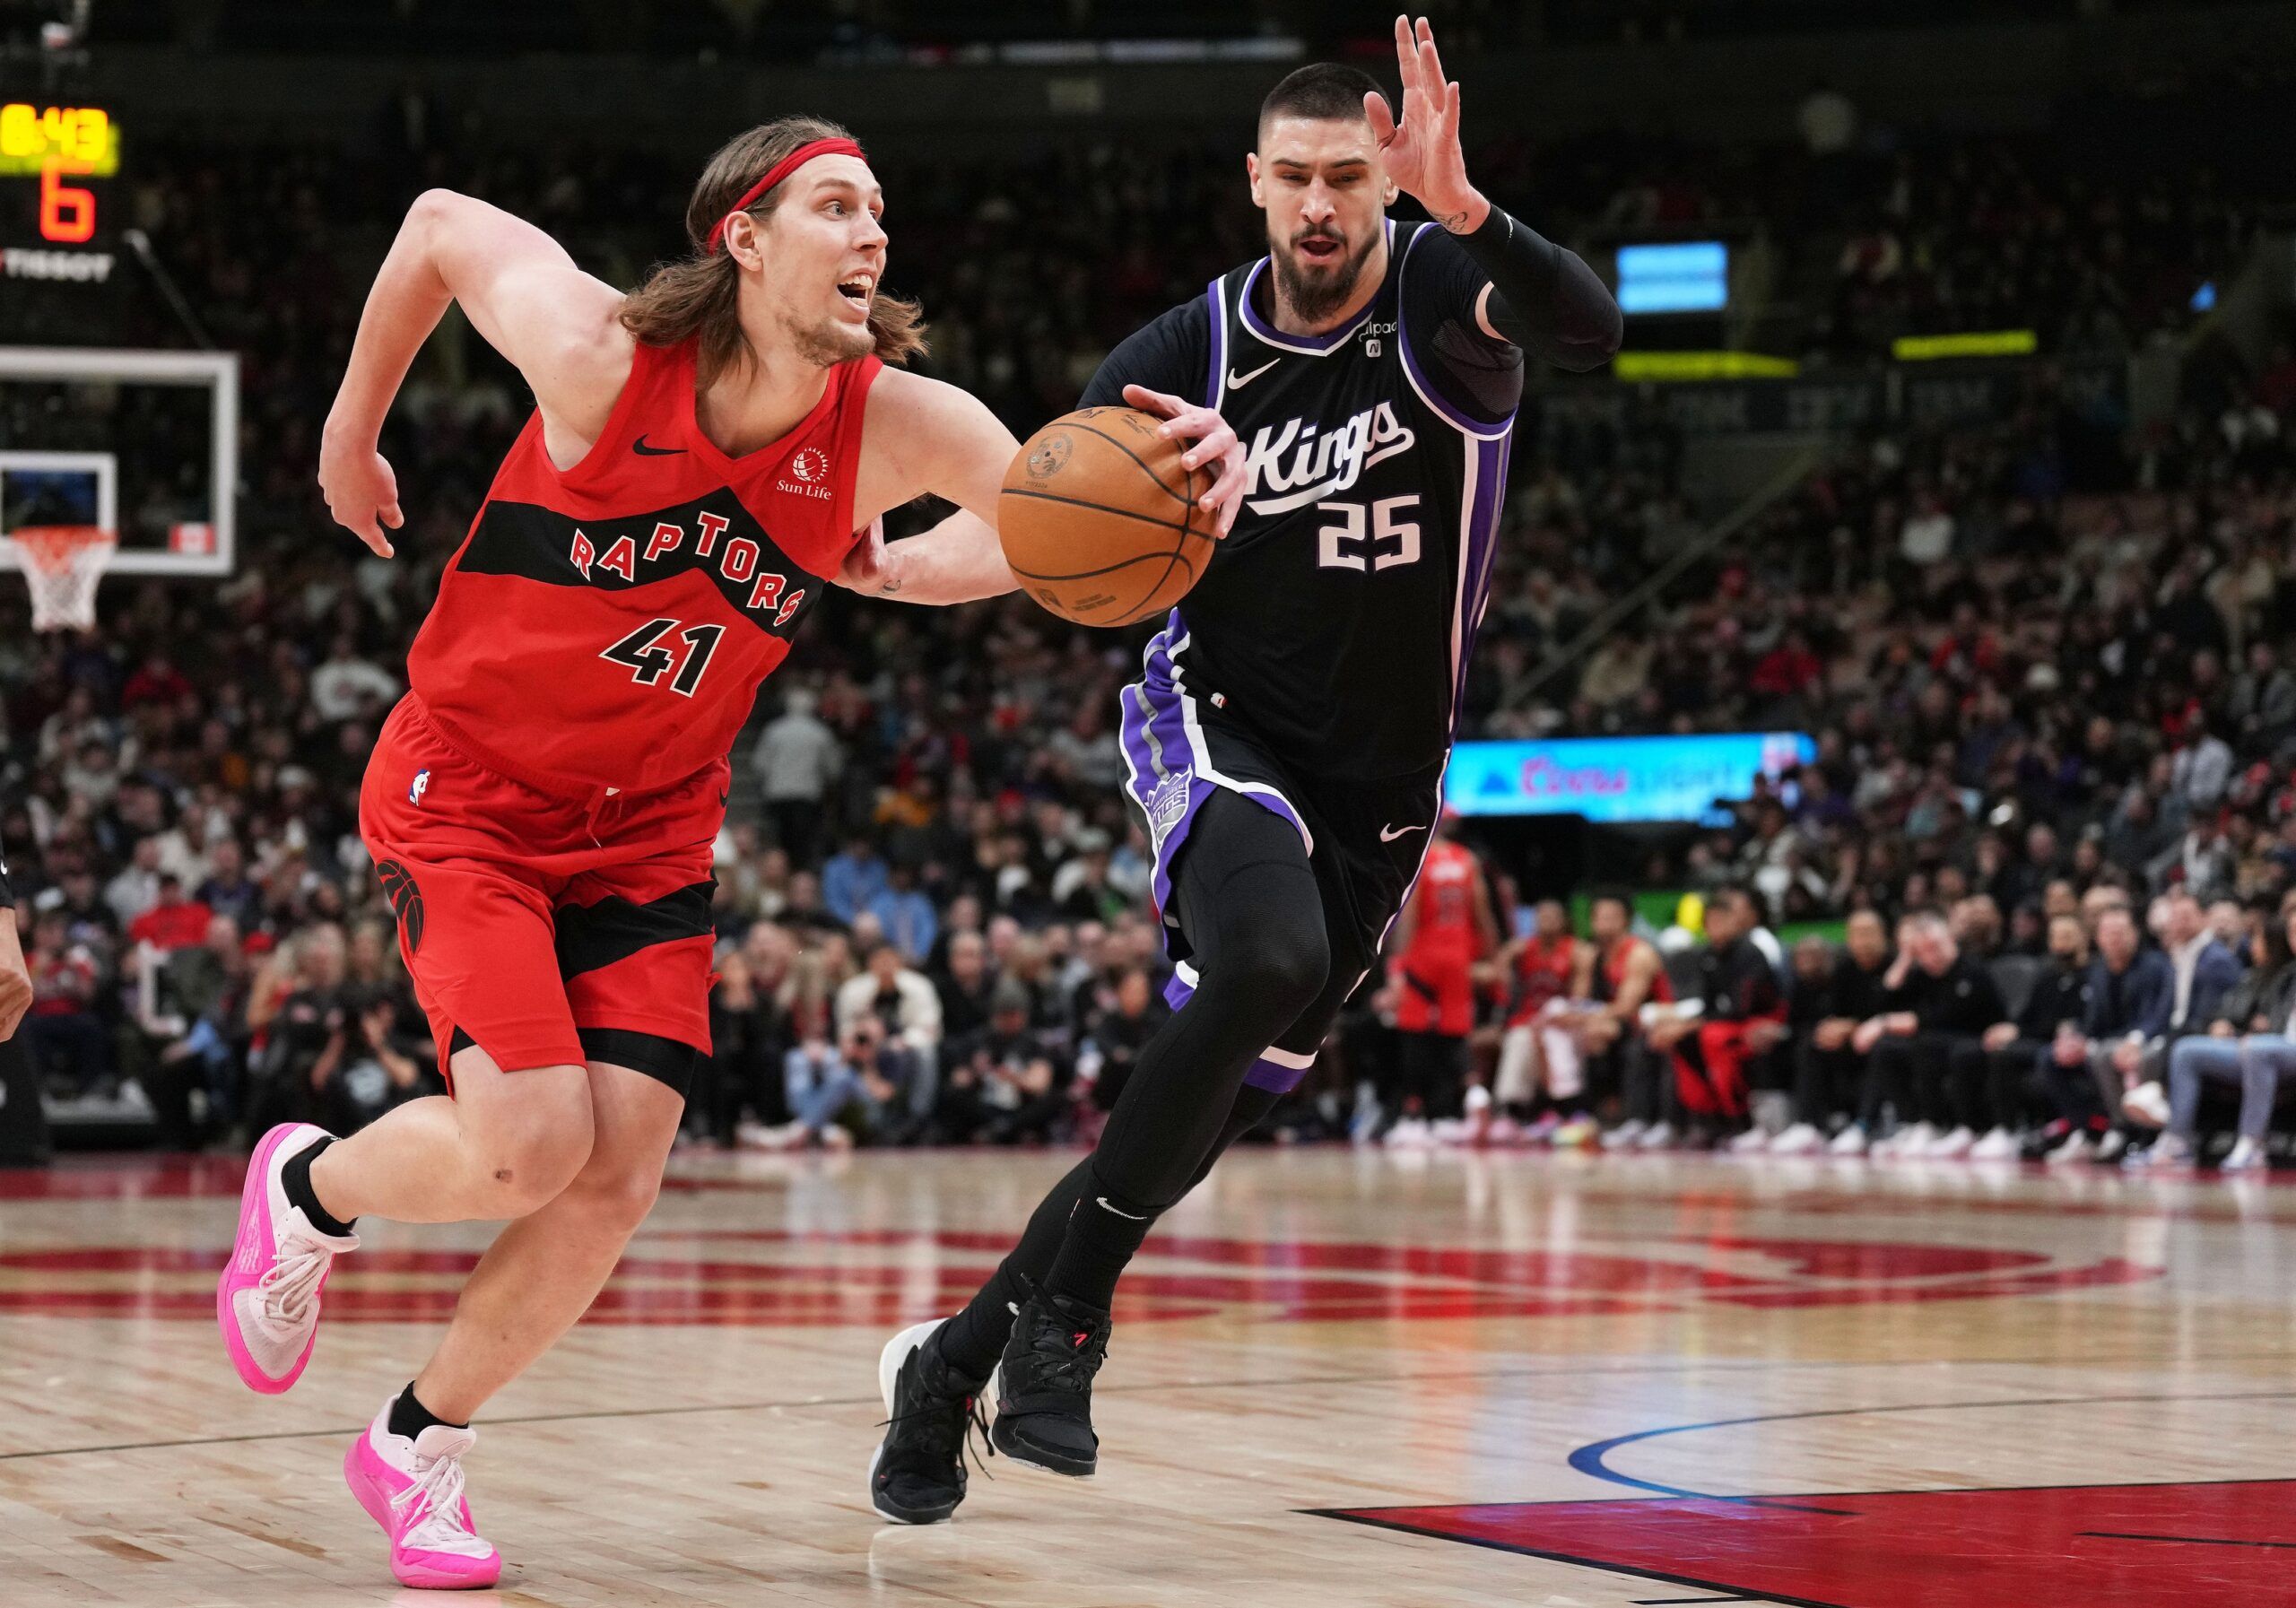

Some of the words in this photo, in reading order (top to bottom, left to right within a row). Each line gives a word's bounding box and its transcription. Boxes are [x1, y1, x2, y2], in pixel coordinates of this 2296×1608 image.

[40, 156, 96, 243] 6
[4, 248, 114, 282] TISSOT
[777, 480, 803, 494] Sun
[806, 484, 831, 500] Life
[1238, 401, 1415, 516] Kings
[570, 511, 804, 627] RAPTORS
[1316, 494, 1421, 571] 25
[599, 618, 726, 699] 41
